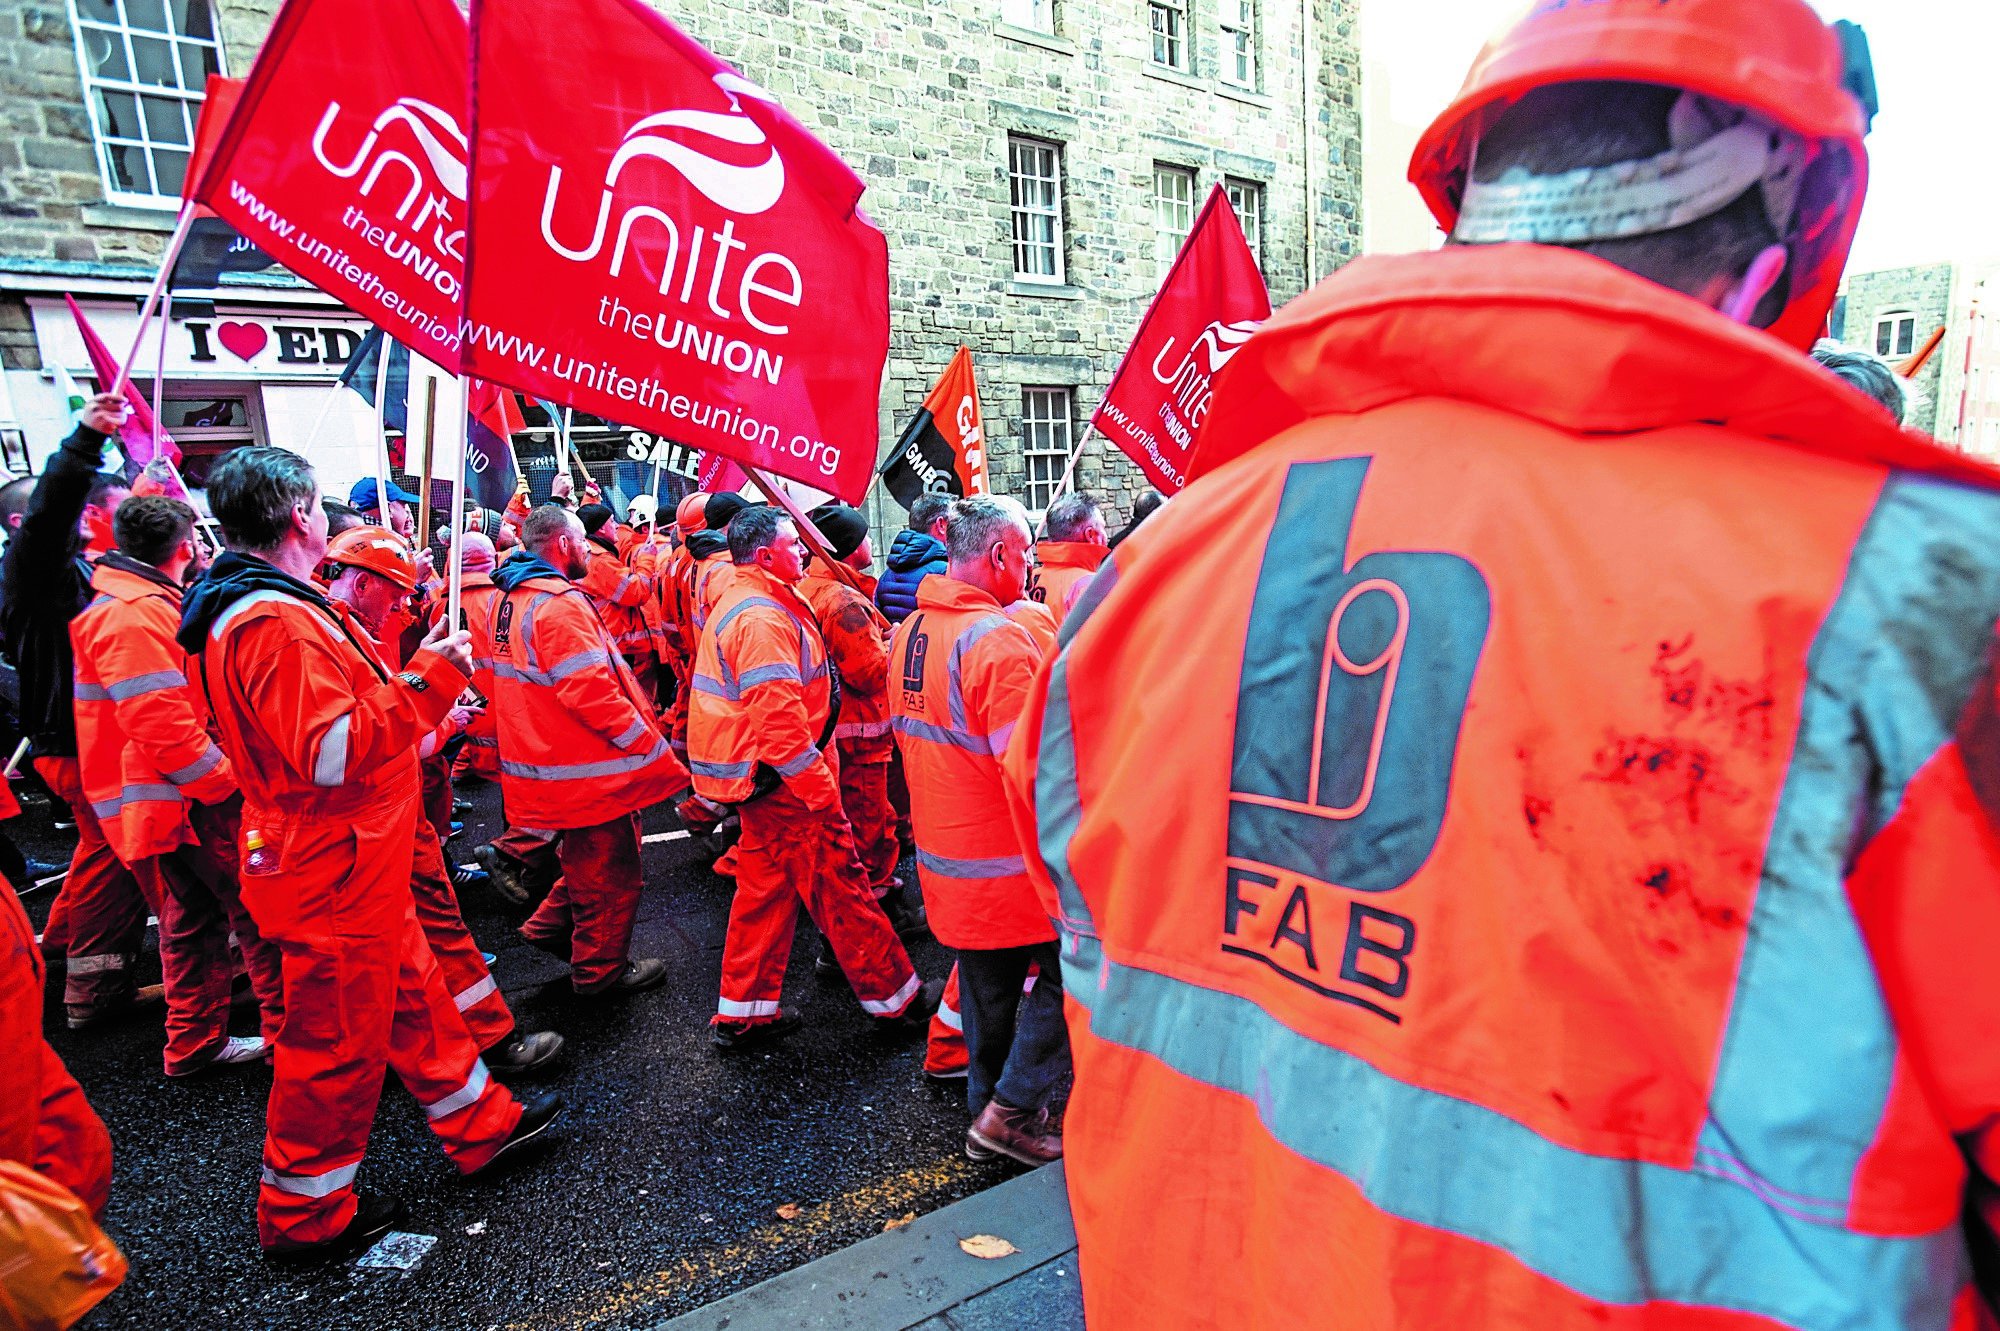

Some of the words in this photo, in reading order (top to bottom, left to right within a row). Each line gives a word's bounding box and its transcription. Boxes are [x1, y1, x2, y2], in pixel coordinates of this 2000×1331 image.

[540, 164, 803, 335] unite
[184, 322, 217, 361] I
[597, 295, 784, 386] theUNION
[1152, 336, 1213, 428] unite
[457, 315, 842, 475] www.unitetheunion.org
[626, 432, 699, 481] SALE
[905, 442, 938, 485] GMB
[1223, 866, 1416, 1000] FAB
